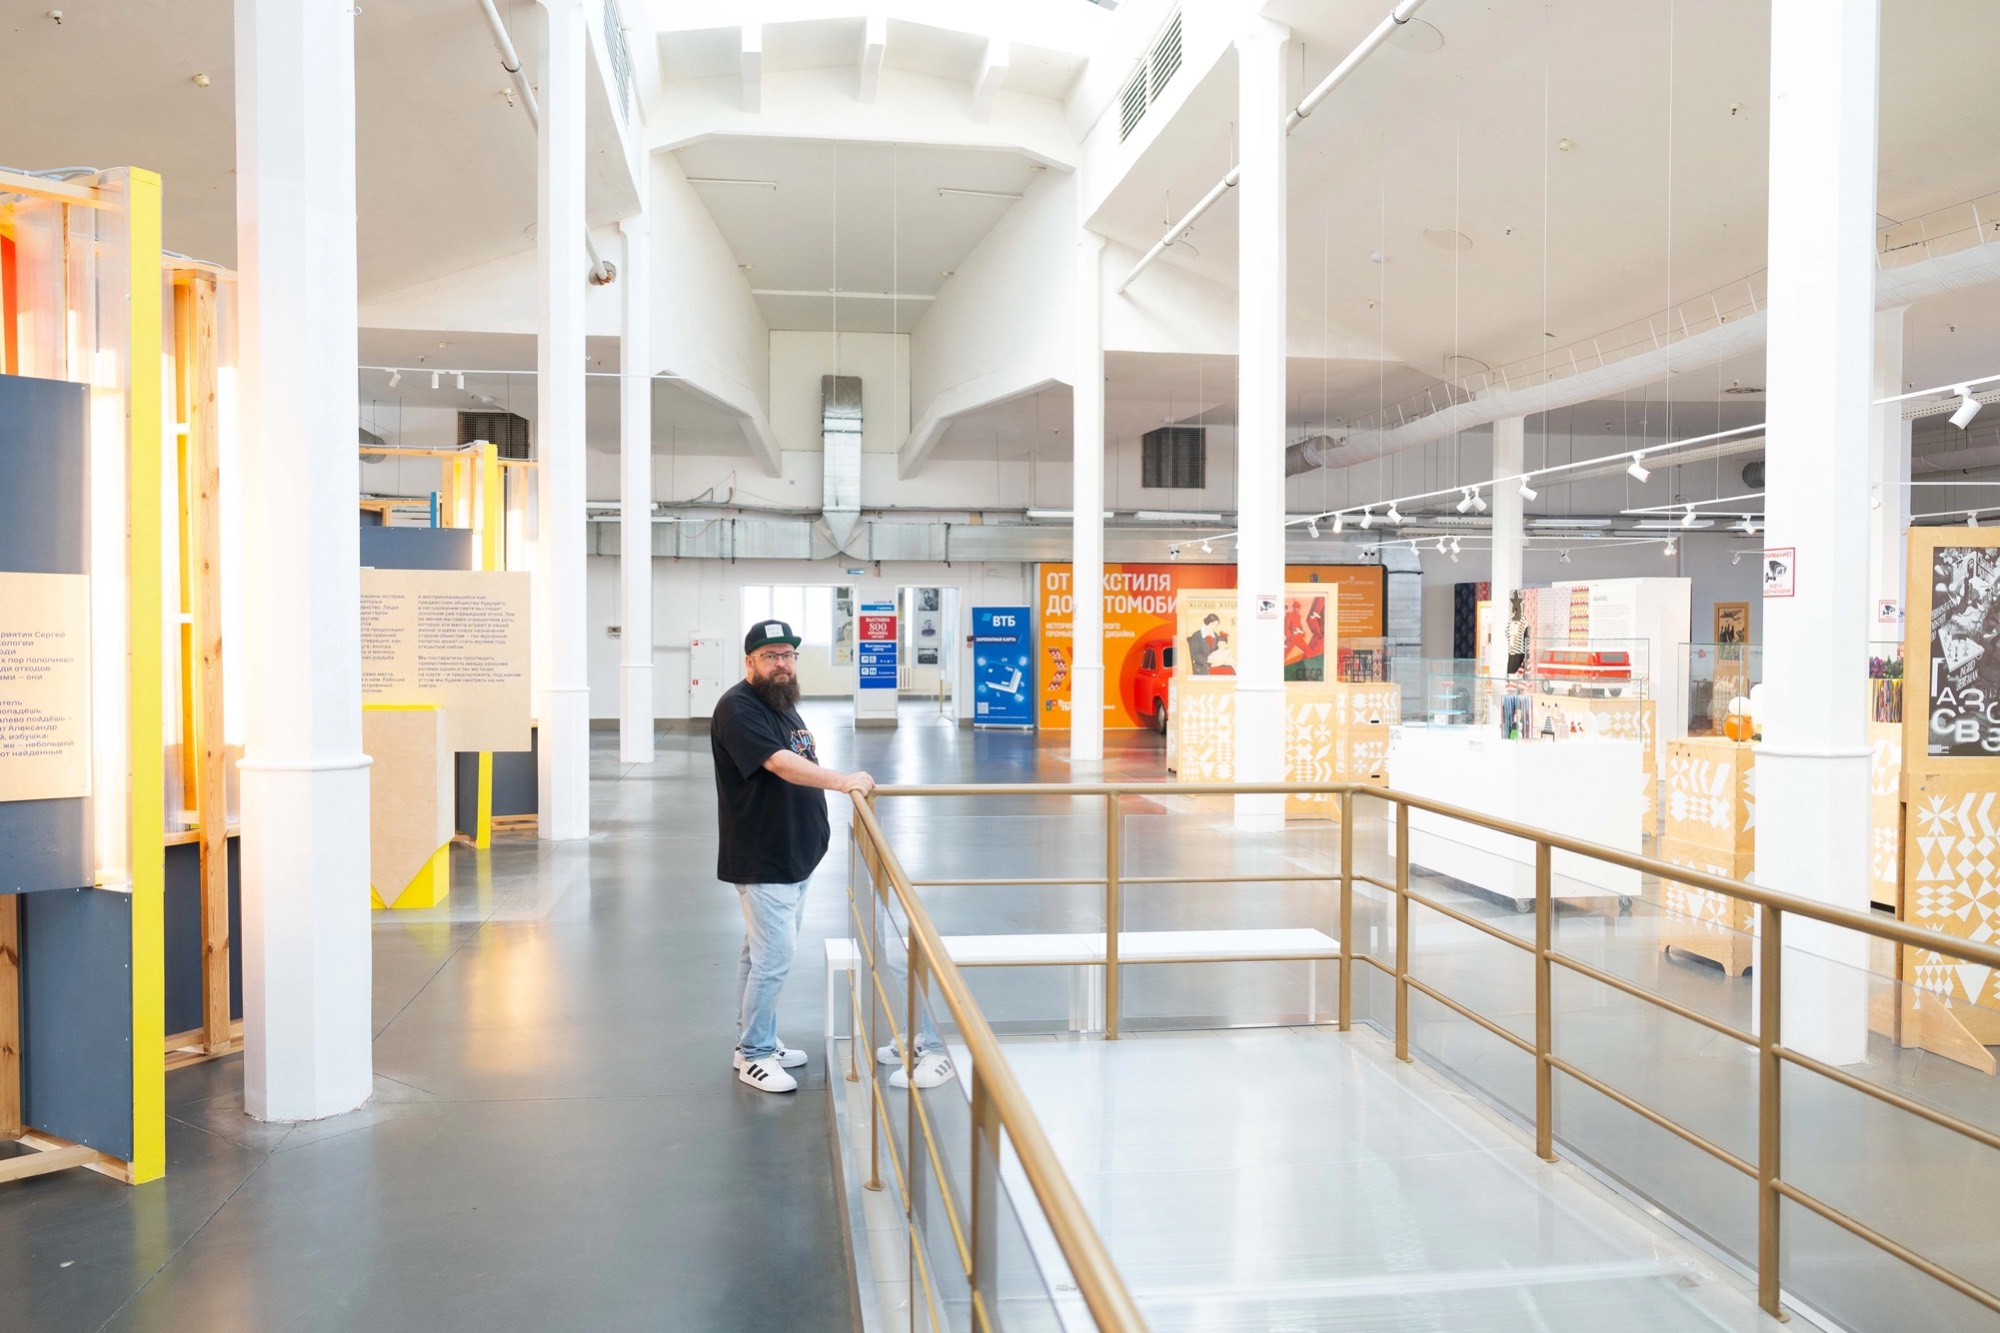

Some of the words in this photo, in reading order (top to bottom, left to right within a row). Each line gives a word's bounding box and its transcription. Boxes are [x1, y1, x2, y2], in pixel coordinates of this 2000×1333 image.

[1047, 572, 1070, 591] ОТ
[1103, 573, 1171, 592] КСТИЛЯ
[1046, 596, 1073, 616] ДО
[1103, 595, 1177, 614] ТОМОБИ
[992, 615, 1016, 627] ВТБ
[869, 622, 887, 632] 800
[34, 631, 66, 639] Сергей
[1104, 630, 1136, 639] ДИЗАЙНА
[8, 657, 25, 665] пор
[25, 740, 75, 748] небольшой
